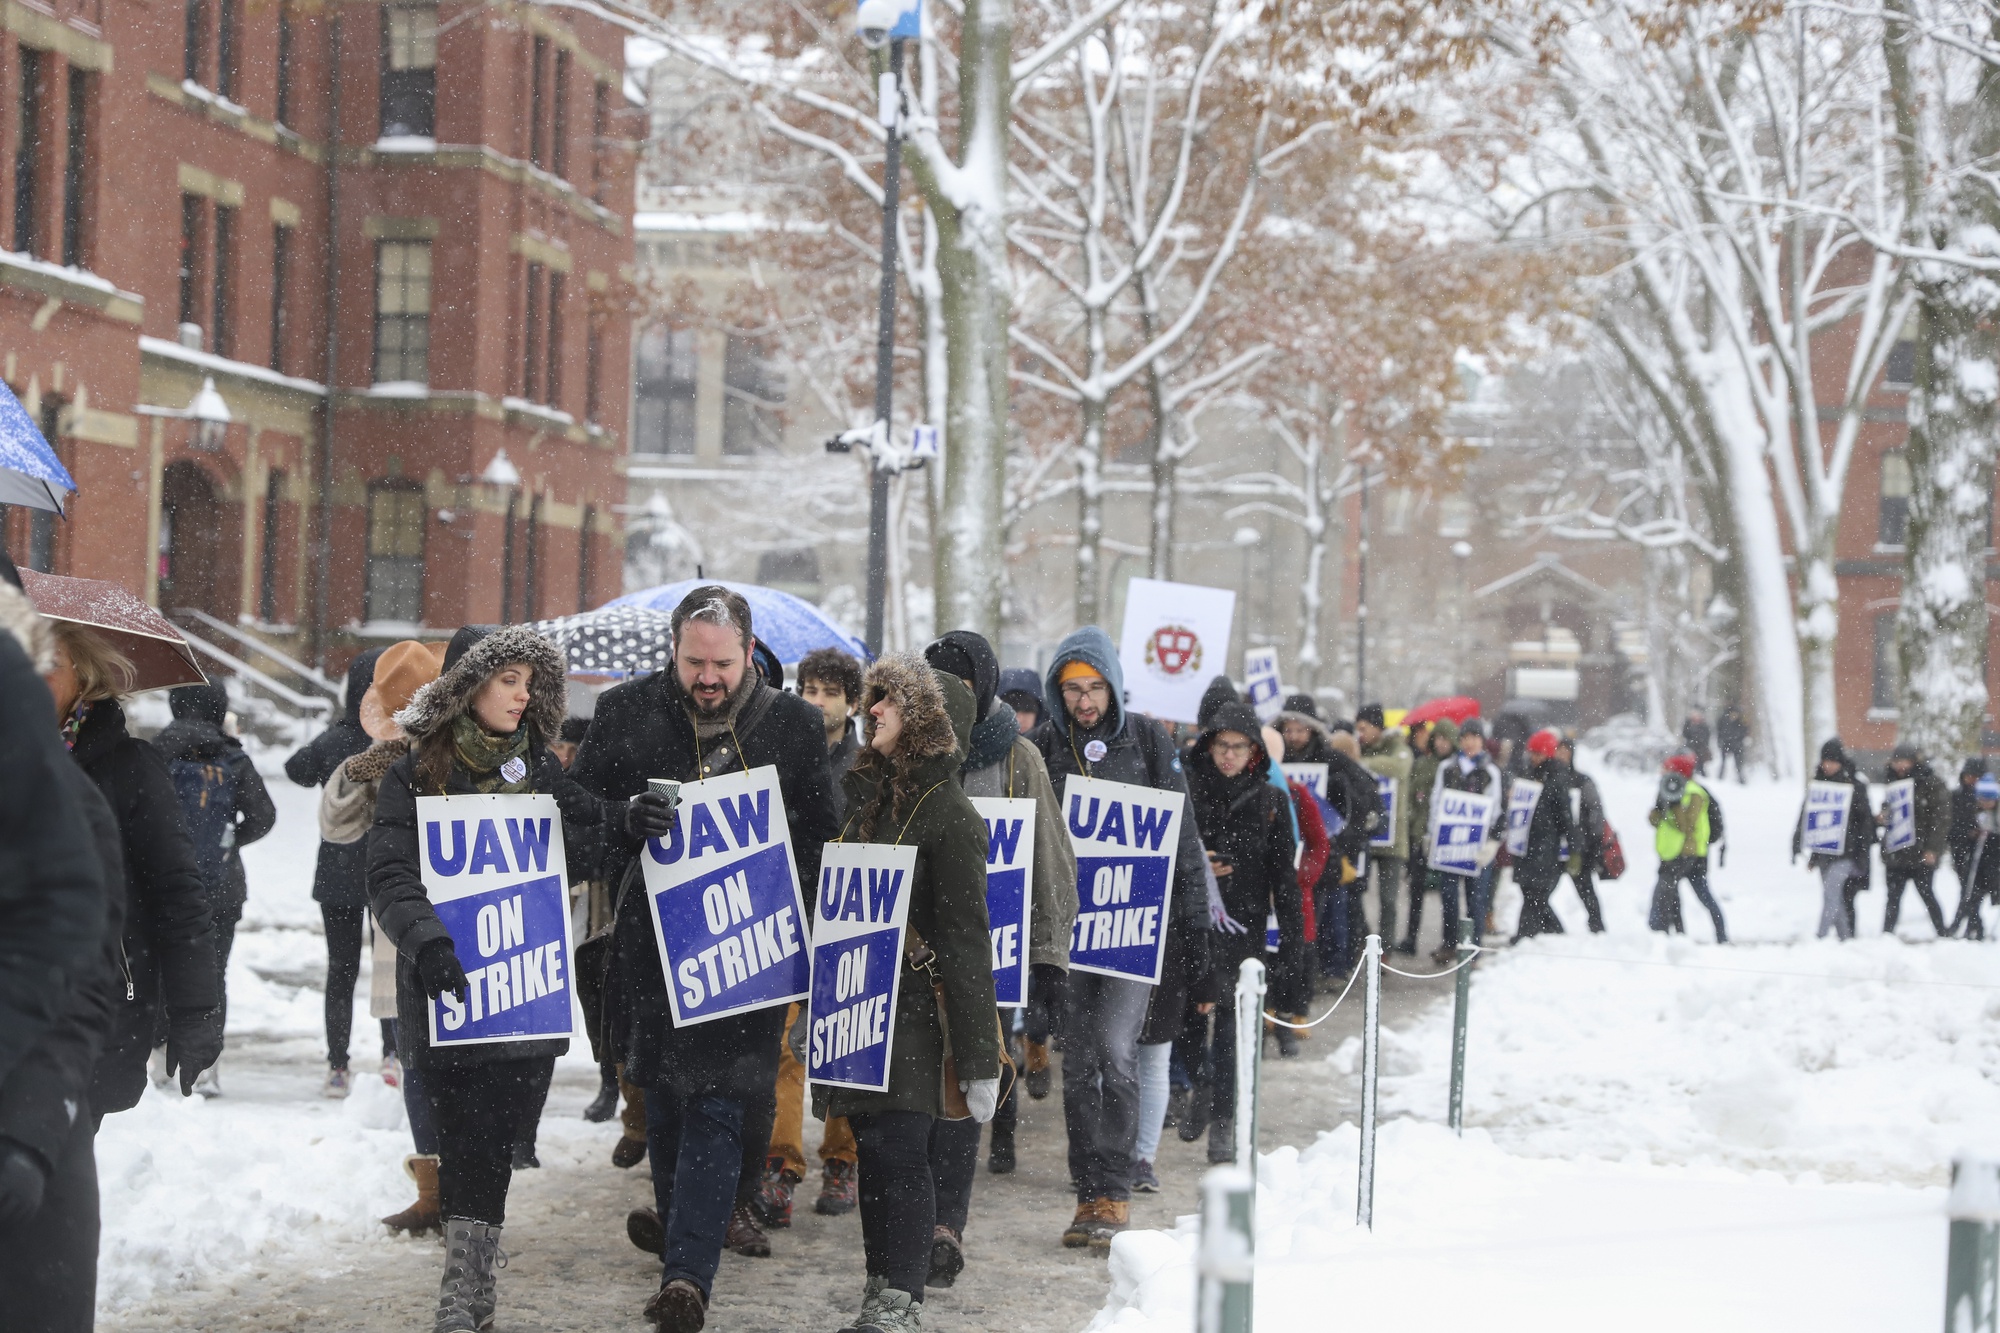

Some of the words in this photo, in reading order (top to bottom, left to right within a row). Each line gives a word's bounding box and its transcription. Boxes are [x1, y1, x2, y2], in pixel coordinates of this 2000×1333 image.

[646, 788, 770, 866] UAW
[1068, 794, 1173, 852] UAW
[1443, 799, 1487, 818] UAW
[426, 817, 551, 877] UAW
[702, 869, 754, 935] ON
[820, 866, 905, 924] UAW
[1092, 864, 1134, 906] ON
[476, 894, 525, 958] ON
[678, 905, 801, 1009] STRIKE
[441, 939, 565, 1031] STRIKE
[835, 944, 869, 1003] ON
[811, 992, 888, 1070] STRIKE
